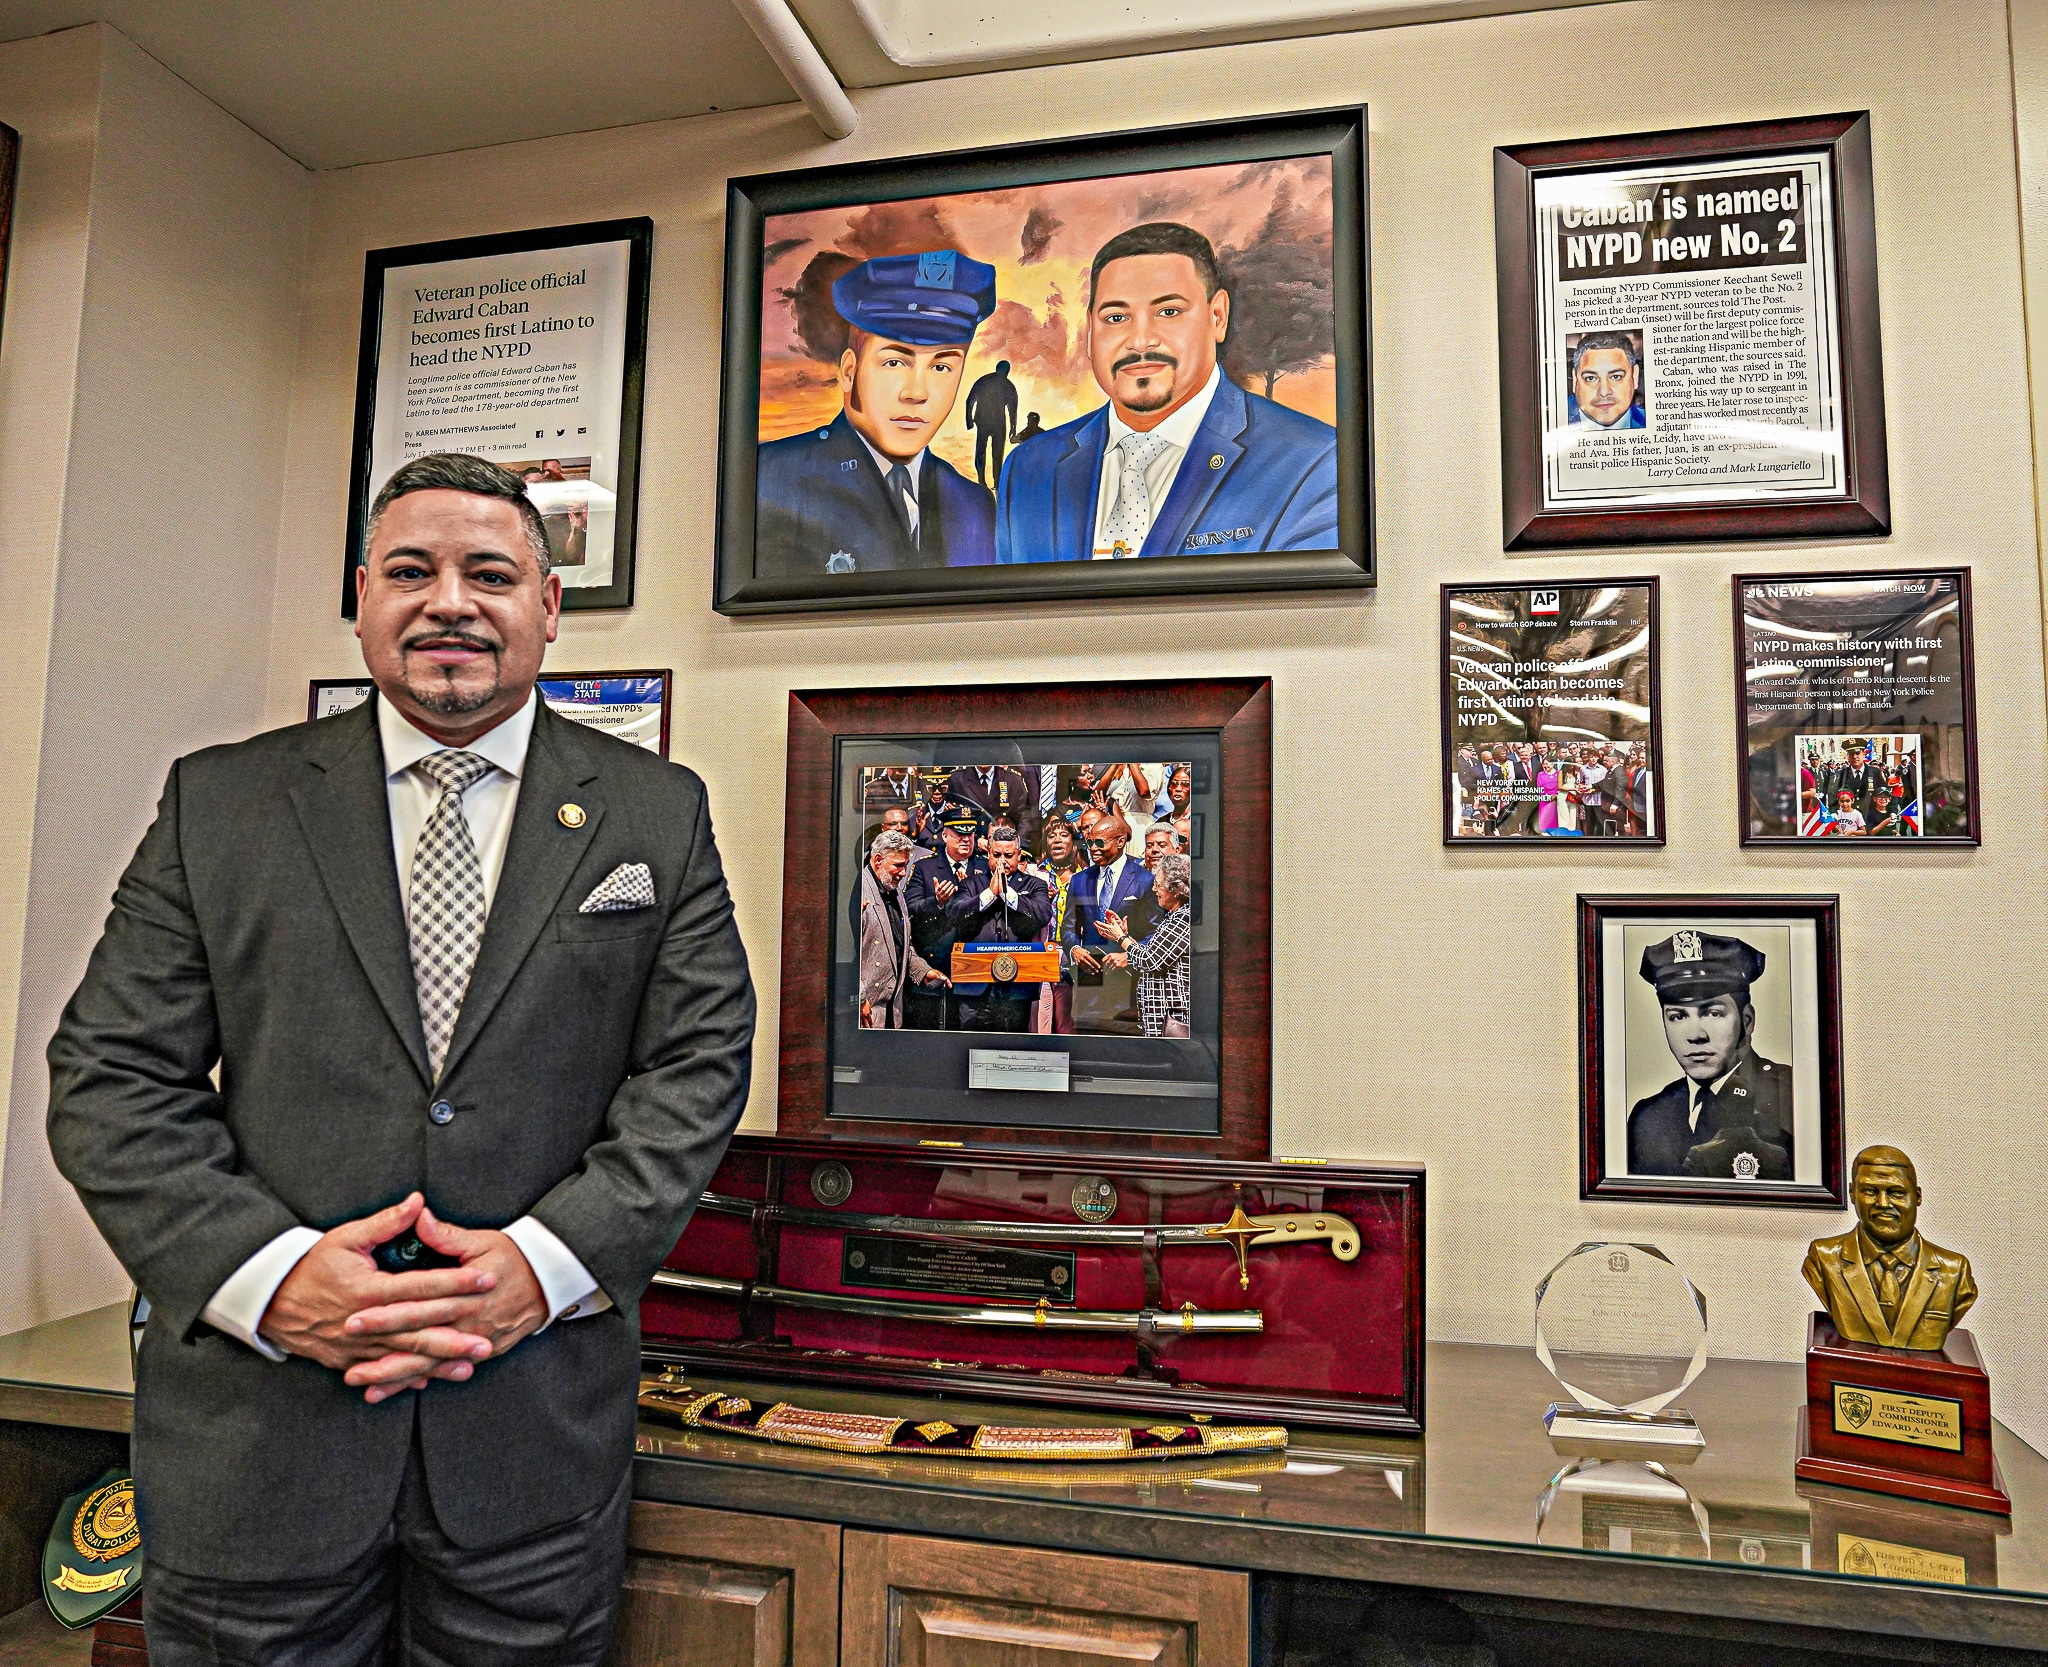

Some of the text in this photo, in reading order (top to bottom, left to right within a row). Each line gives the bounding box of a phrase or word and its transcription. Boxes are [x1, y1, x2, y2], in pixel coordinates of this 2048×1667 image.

[1562, 177, 1799, 229] Caban is named
[1567, 219, 1797, 269] NYPD new No. 2
[414, 269, 586, 303] Veteran police official
[1572, 271, 1803, 296] Incoming NYPD Commissioner Keechant Sewell
[1565, 298, 1580, 308] has
[1583, 296, 1613, 308] picked
[1623, 294, 1659, 304] 30-year
[1661, 291, 1692, 301] NYPD
[1694, 288, 1730, 298] veteran
[1733, 288, 1743, 296] to
[1745, 286, 1757, 295] be
[1759, 285, 1775, 293] the
[1777, 284, 1795, 293] No.
[1797, 282, 1804, 291] 2
[412, 300, 530, 324] Edward Caban
[1565, 295, 1786, 320] person in the department, sources told The Post.
[1574, 305, 1804, 328] Edward Caban (inset) will be first deputy commis-
[411, 315, 595, 346] becomes first Latino to
[409, 341, 532, 367] head the NYPD
[408, 362, 577, 386] Longtime police official Edward Caban has
[407, 387, 427, 396] been
[429, 385, 453, 394] sworn
[454, 383, 461, 392] is
[473, 378, 531, 390] commissioner
[532, 375, 541, 384] of
[542, 375, 556, 383] the
[557, 373, 577, 382] New
[407, 384, 579, 407] York Police Department, becoming the first
[405, 395, 580, 418] Latino to lead the 178-year-old department
[404, 423, 516, 439] By KAREN MATTHEWS Associated
[1647, 461, 1811, 478] Larry Celona and Mark Lungariello
[1768, 586, 1814, 598] NEWS
[1873, 584, 1927, 593] WATCH NOW
[1533, 592, 1558, 606] AP
[1753, 636, 1943, 653] NYPD makes history with first
[1457, 661, 1512, 674] Veteran
[1514, 659, 1556, 676] police
[1753, 656, 1887, 668] Latino commissioner
[575, 681, 594, 690] CITY
[1457, 676, 1624, 691] Edward Caban becomes
[1754, 678, 1784, 686] Edward
[1811, 677, 1829, 685] who
[1829, 677, 1837, 685] is
[1837, 676, 1847, 685] of
[1847, 676, 1873, 684] Puerto
[1874, 676, 1896, 684] Rican
[1929, 675, 1937, 683] is
[1937, 675, 1951, 683] the
[574, 690, 600, 698] STATE
[1457, 695, 1487, 709] first
[612, 705, 643, 713] NYPD's
[571, 716, 625, 725] ommissioner
[1458, 713, 1498, 727] NYPD
[1879, 1411, 1950, 1429] COMMISSIONER
[1881, 1404, 1946, 1420] FIRST DEPUTY
[1872, 1420, 1957, 1439] EDWARD A. CABAN
[83, 1523, 103, 1547] DUBAI
